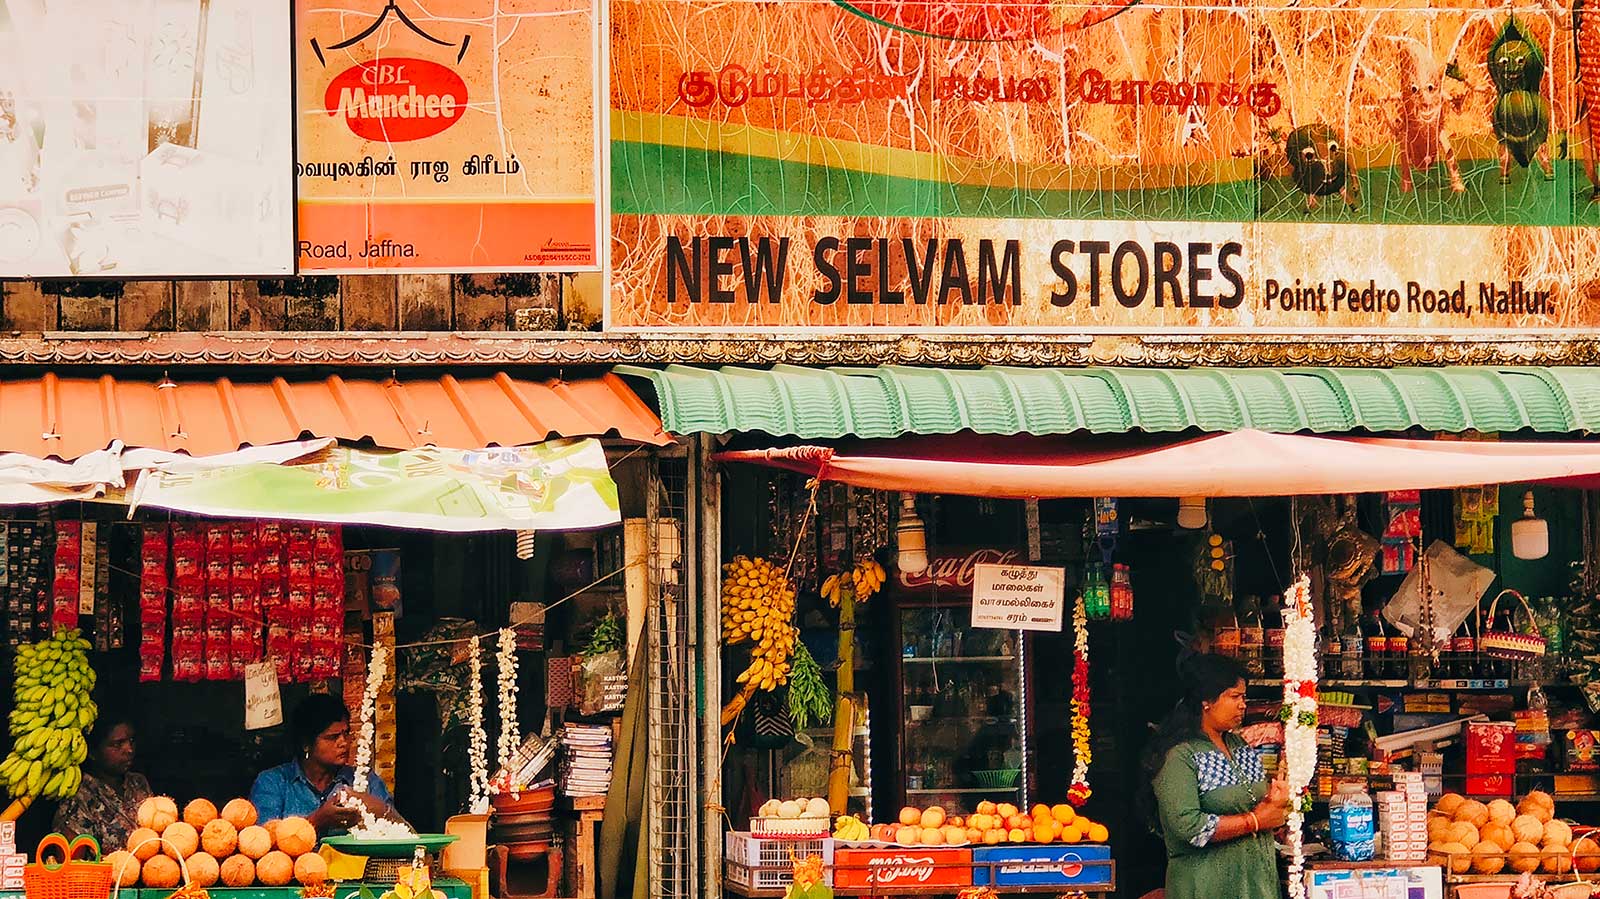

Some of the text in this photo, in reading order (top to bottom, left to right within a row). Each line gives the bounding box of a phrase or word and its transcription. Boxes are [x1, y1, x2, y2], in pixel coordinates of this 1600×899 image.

[361, 64, 410, 85] CBL
[337, 85, 456, 119] Munchee
[410, 160, 449, 182] ராஜ
[462, 154, 520, 175] கிரீடம்
[298, 239, 420, 261] Road, Jaffna.
[666, 236, 1246, 309] NEW SELVAM STORES
[1265, 278, 1556, 318] Point Pedro Road, Nallur.
[1000, 565, 1039, 580] கழுத்து
[991, 582, 1044, 593] மாலைகள்
[1006, 611, 1028, 623] சரம்
